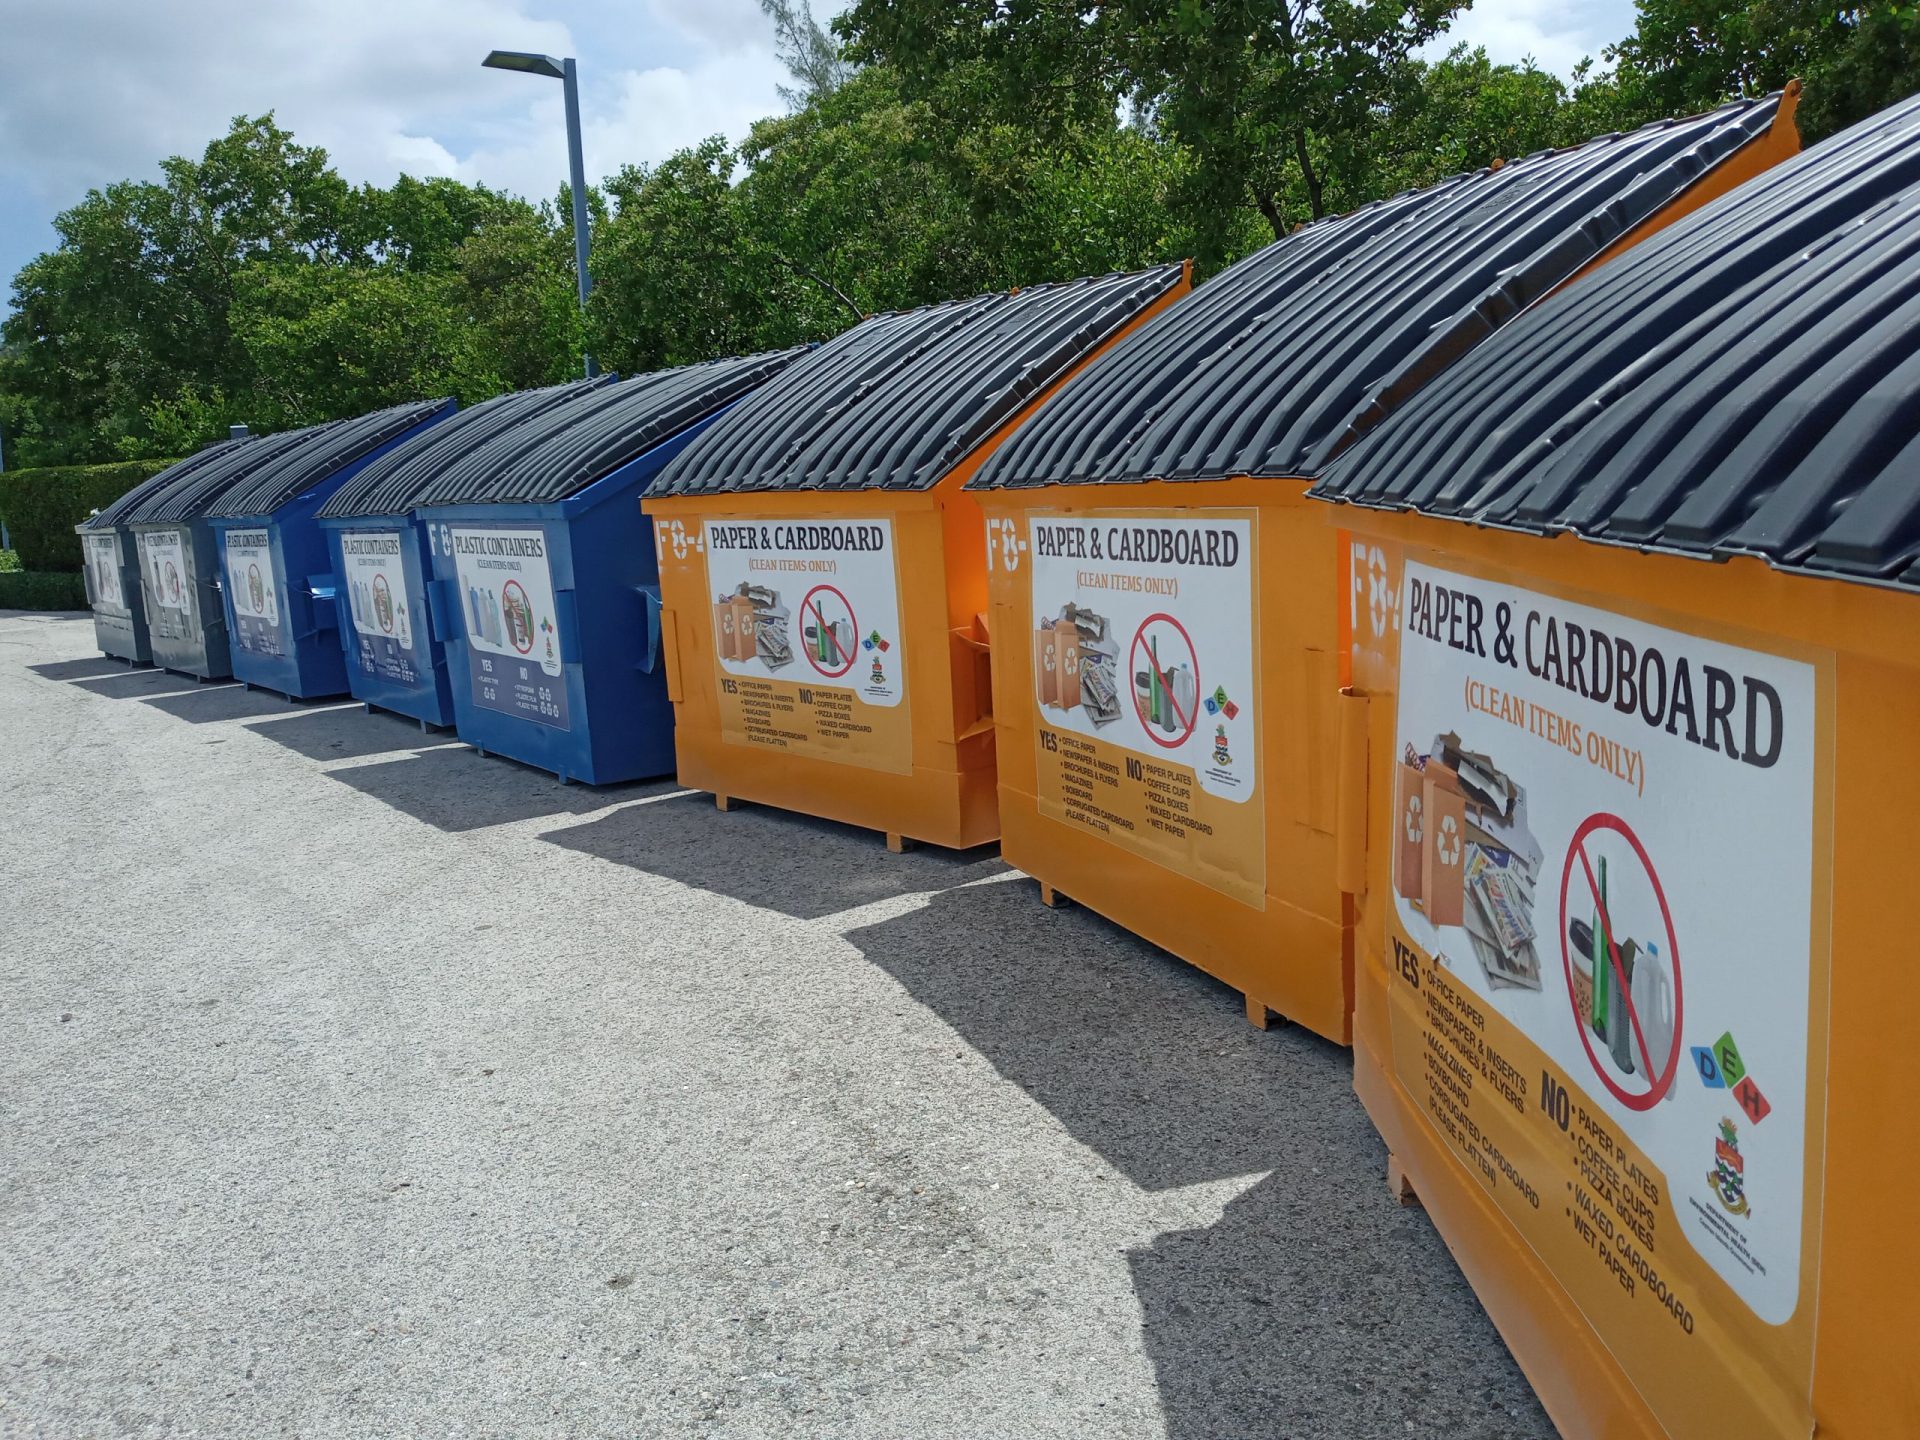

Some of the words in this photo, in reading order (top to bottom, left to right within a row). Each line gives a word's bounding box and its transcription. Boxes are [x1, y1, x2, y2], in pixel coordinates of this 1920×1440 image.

[344, 539, 364, 554] PLASTIC
[365, 539, 399, 555] CONTAINERS
[455, 536, 487, 554] PLASTIC
[487, 537, 543, 557] CONTAINERS
[711, 526, 757, 551] PAPER
[761, 526, 771, 551] &
[774, 526, 884, 551] CARDBOARD
[1037, 526, 1087, 559] PAPER
[1090, 527, 1103, 560] &
[1107, 527, 1239, 568] CARDBOARD
[749, 558, 777, 572] (CLEAN
[779, 559, 806, 572] ITEMS
[809, 560, 836, 575] ONLY)
[1076, 569, 1108, 590] (CLEAN
[1111, 574, 1142, 593] ITEMS
[1144, 577, 1178, 599] ONLY)
[481, 659, 492, 672] YES
[520, 666, 528, 680] NO
[1409, 577, 1486, 658] PAPER
[1493, 601, 1518, 668] &
[1525, 610, 1784, 768] CARDBOARD
[721, 678, 738, 694] YES
[799, 688, 813, 705] NO
[816, 691, 832, 699] PAPER
[834, 693, 852, 702] PLATES
[817, 701, 837, 709] COFFEE
[838, 703, 851, 711] CUPS
[818, 710, 833, 718] PIZZA
[834, 712, 850, 720] BOXES
[819, 720, 837, 728] WAXED
[839, 722, 872, 733] CARDBOARD
[832, 731, 849, 739] PAPER
[1464, 675, 1525, 728] (CLEAN
[1529, 703, 1582, 757] ITEMS
[1587, 735, 1644, 798] ONLY)
[1040, 729, 1058, 752] YES
[1062, 736, 1080, 749] OFFICE
[1081, 742, 1096, 754] PAPER
[1063, 749, 1092, 765] NEWSPAPER
[1098, 760, 1119, 775] INSERTS
[1064, 761, 1094, 778] BROCHURES
[1099, 773, 1119, 788] FLYERS
[1126, 757, 1142, 781] NO
[1146, 764, 1166, 778] PAPER
[1167, 770, 1191, 785] PLATES
[1064, 773, 1093, 790] MAGAZINES
[1147, 778, 1171, 793] COFFEE
[1172, 786, 1191, 799] CUPS
[1066, 797, 1100, 816] CORRUGATED
[1101, 810, 1134, 830] CARDBOARD
[1148, 791, 1166, 805] PIZZA
[1167, 798, 1188, 812] BOXES
[1086, 816, 1109, 834] FLATTEN)
[1149, 804, 1171, 820] WAXED
[1172, 813, 1213, 835] CARDBOARD
[1150, 818, 1163, 831] WET
[1165, 823, 1185, 839] PAPER
[1392, 935, 1420, 989] YES
[1427, 969, 1454, 1005] OFFICE
[1456, 995, 1485, 1032] PAPER
[1427, 990, 1476, 1048] NEWSPAPER
[1478, 1039, 1485, 1055] &
[1487, 1045, 1527, 1095] INSERTS
[1428, 1032, 1473, 1089] MAGAZINES
[1428, 1055, 1469, 1108] BOXBOARD
[1481, 1062, 1488, 1079] &
[1489, 1071, 1525, 1114] FLYERS
[1541, 1069, 1570, 1132] NO
[1429, 1094, 1457, 1140] (PLEASE
[1458, 1132, 1496, 1188] FLATTEN)
[1429, 1075, 1480, 1142] CORRUGATED
[1482, 1136, 1540, 1209] CARDBOARD
[1578, 1106, 1613, 1157] PAPER
[1616, 1146, 1659, 1206] PLATES
[1578, 1135, 1620, 1193] COFFEE
[1623, 1183, 1655, 1231] CUPS
[1581, 1160, 1613, 1207] PIZZA
[1616, 1198, 1654, 1252] BOXES
[1574, 1210, 1597, 1249] WET
[1599, 1242, 1635, 1299] PAPER
[1575, 1184, 1614, 1240] WAXED
[1616, 1234, 1694, 1335] CARDBOARD
